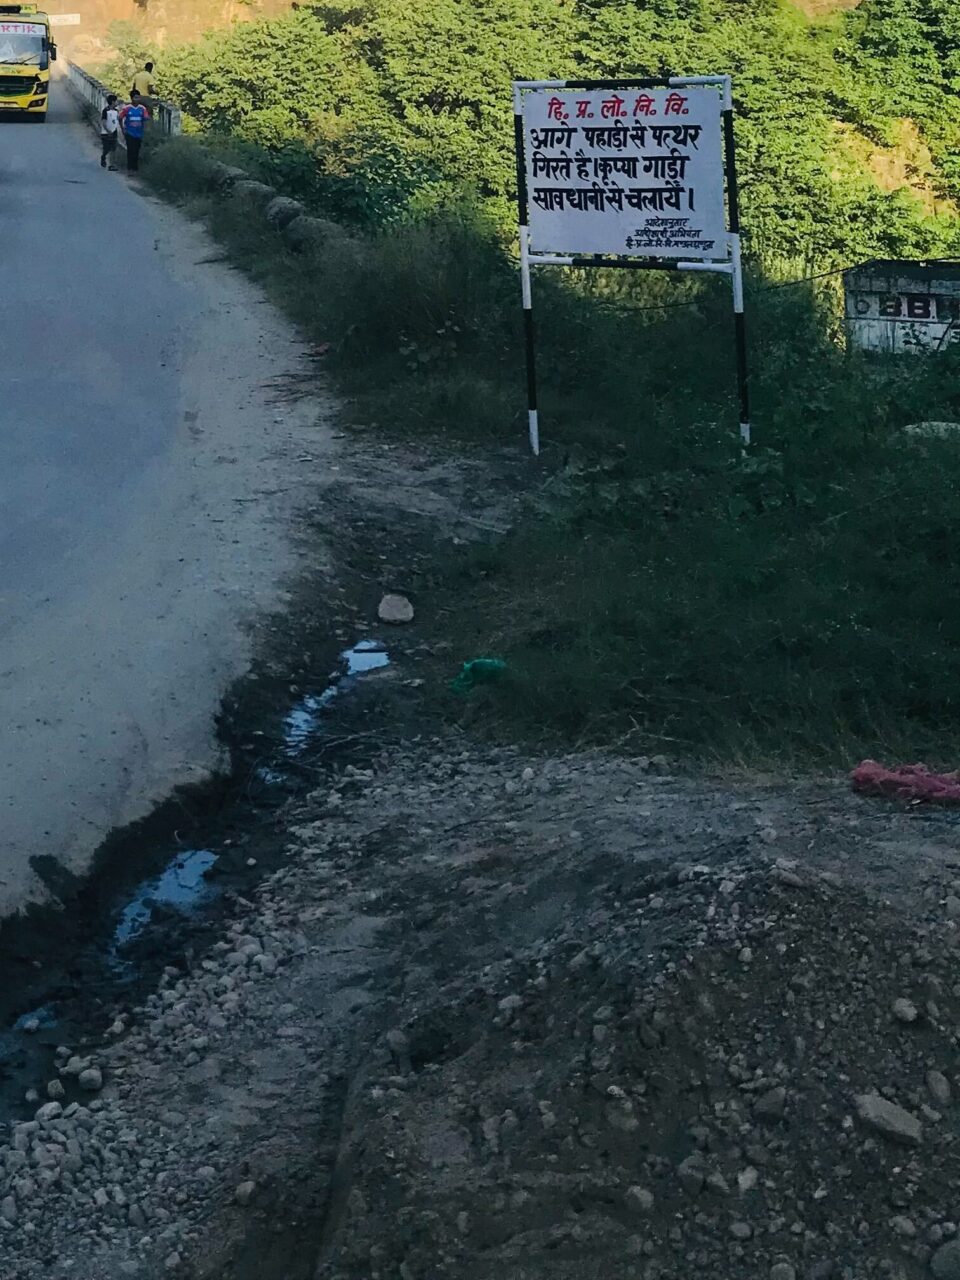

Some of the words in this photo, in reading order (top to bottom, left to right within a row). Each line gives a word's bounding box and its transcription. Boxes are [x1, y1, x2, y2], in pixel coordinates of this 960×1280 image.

[530, 121, 578, 150] आगे
[581, 119, 630, 152] पहाड़ी
[629, 119, 649, 151] से
[647, 124, 703, 150] पत्थर
[531, 150, 574, 181] गिरते
[641, 147, 691, 183] गाड़ी
[532, 181, 606, 212] सावधानी
[605, 180, 625, 213] से
